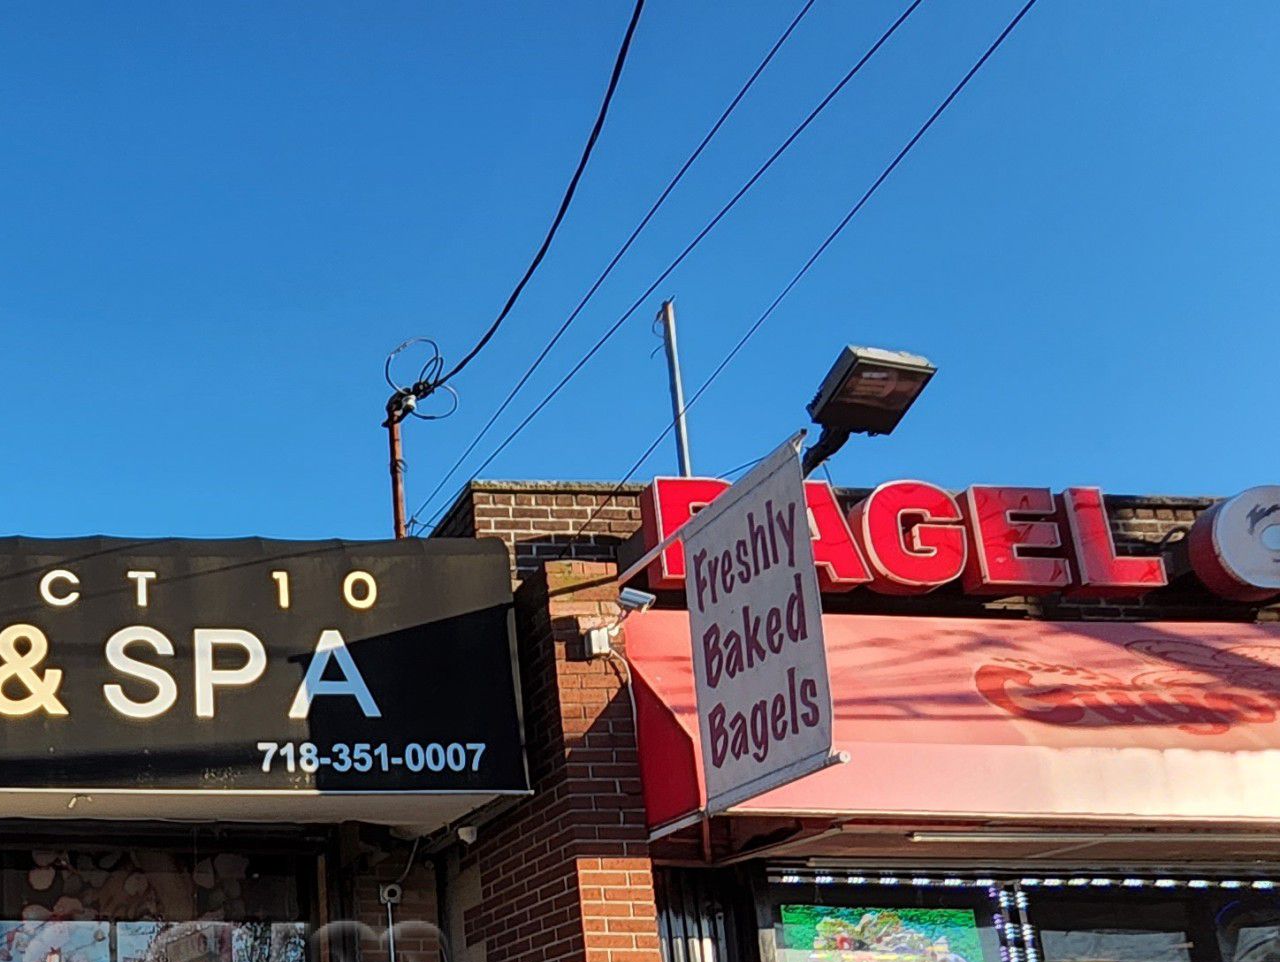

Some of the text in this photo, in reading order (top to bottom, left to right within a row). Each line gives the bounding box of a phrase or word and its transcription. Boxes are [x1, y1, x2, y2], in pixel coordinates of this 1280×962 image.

[693, 500, 796, 613] Freshly
[103, 625, 382, 719] SPA
[703, 572, 808, 689] Baked
[257, 741, 487, 774] 718-351-0007
[708, 667, 820, 769] Bagels
